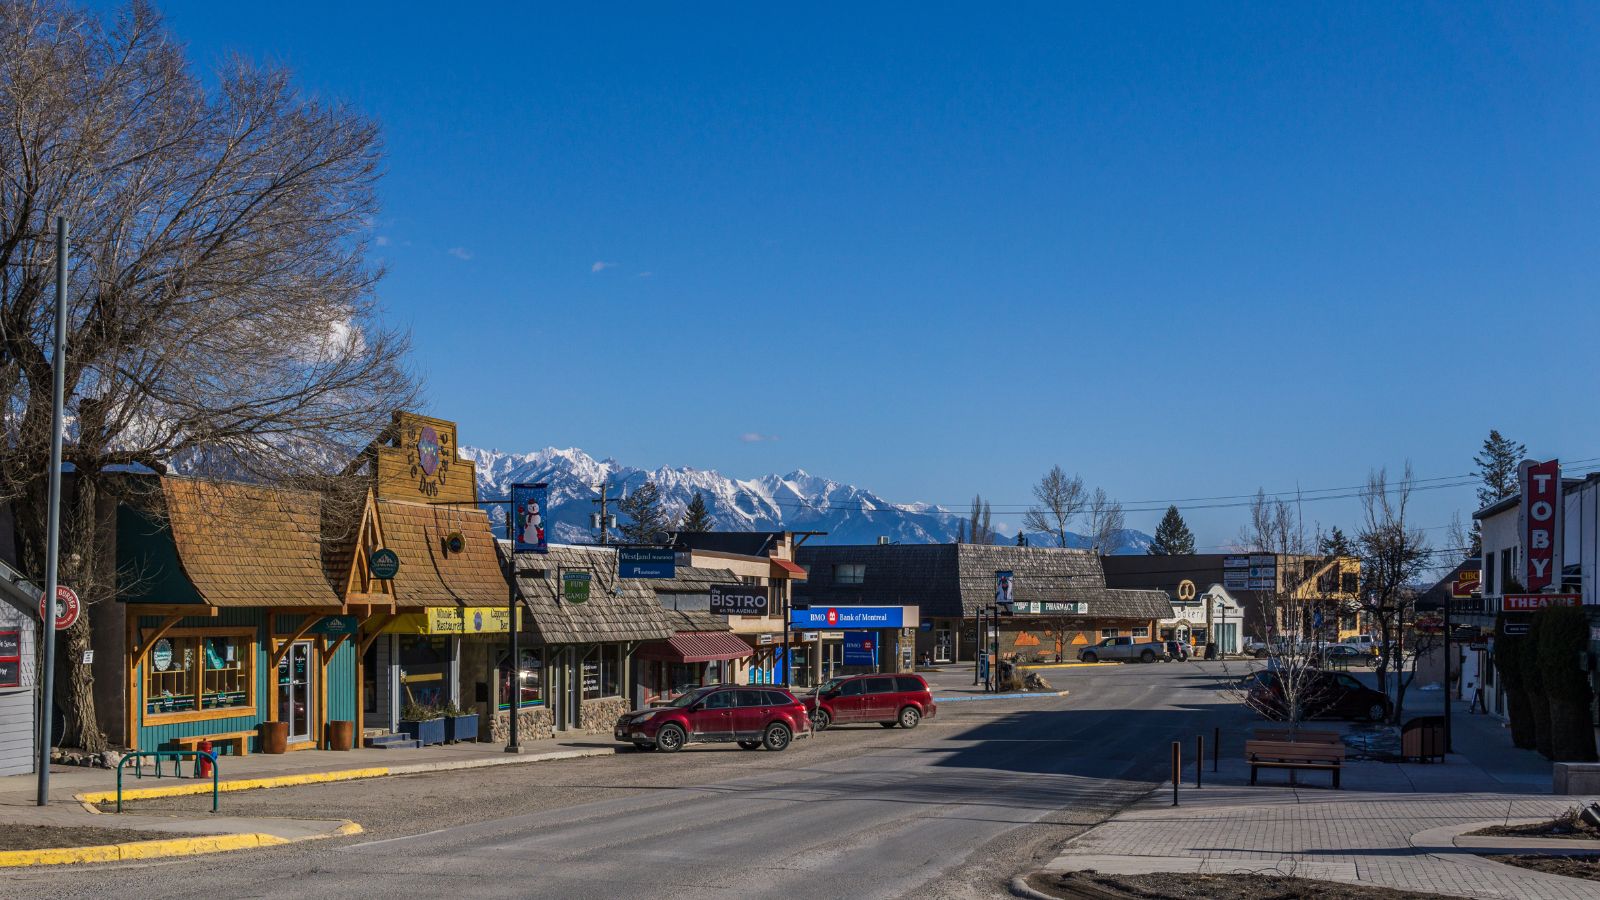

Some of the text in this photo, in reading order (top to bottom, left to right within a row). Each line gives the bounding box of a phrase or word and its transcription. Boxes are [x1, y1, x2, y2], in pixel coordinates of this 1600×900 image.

[1530, 475, 1553, 578] TOBY
[620, 552, 651, 561] Westland
[1460, 572, 1479, 580] CIBC
[58, 589, 76, 609] BURGER
[711, 595, 767, 607] BISTRO
[1045, 602, 1073, 611] PHARMACY
[810, 613, 887, 621] BMO Bank of Montreal
